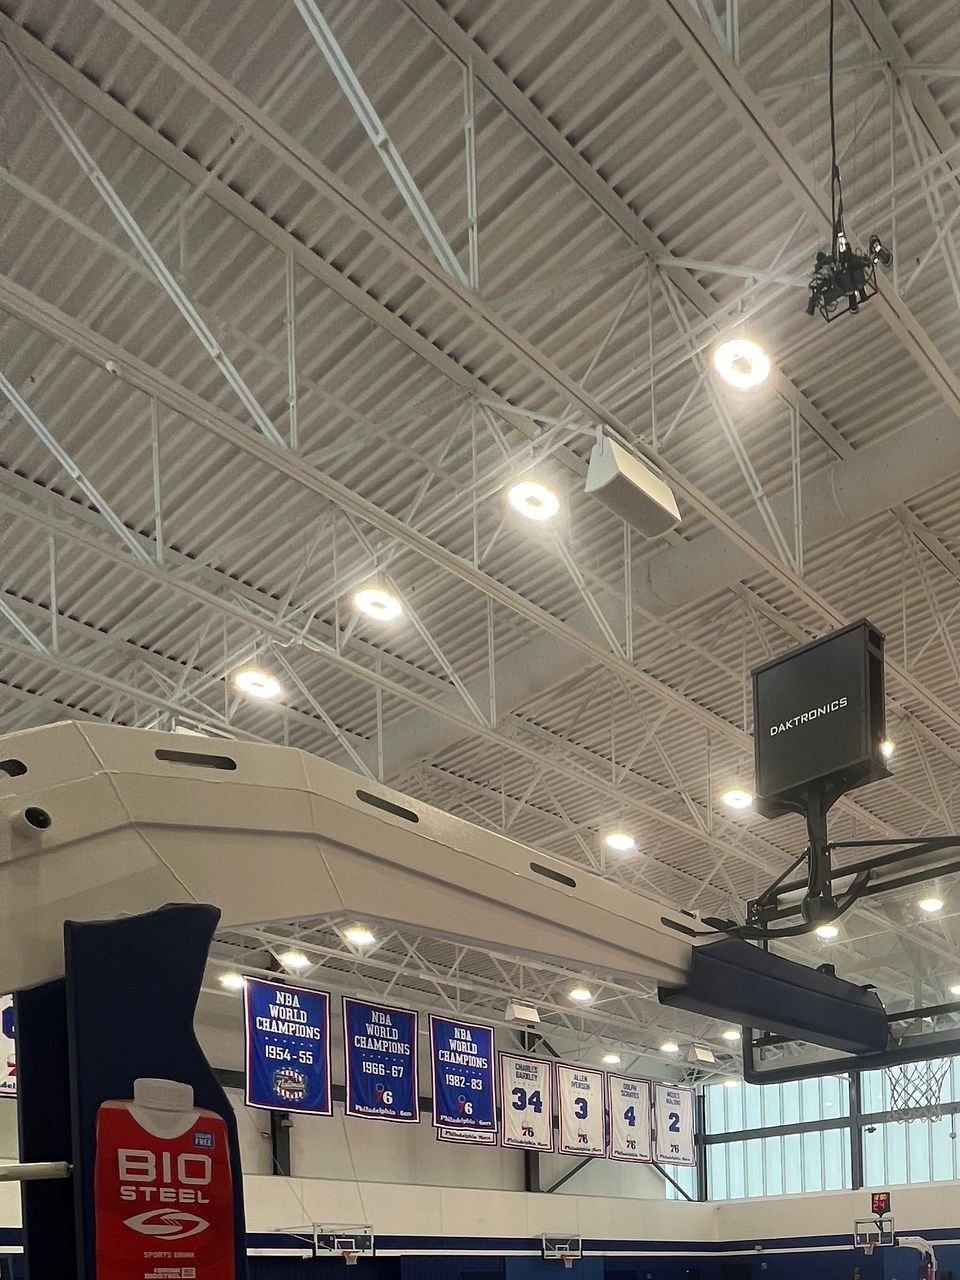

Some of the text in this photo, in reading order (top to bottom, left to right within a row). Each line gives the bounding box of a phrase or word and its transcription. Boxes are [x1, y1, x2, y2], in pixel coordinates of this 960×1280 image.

[769, 696, 848, 736] DAKTRONICS
[276, 991, 300, 1008] NBA
[269, 1004, 308, 1023] WORLD
[371, 1011, 392, 1026] NBA
[256, 1017, 320, 1040] CHAMPIONS
[366, 1024, 398, 1040] WORLD
[454, 1028, 472, 1042] NBA
[354, 1036, 410, 1055] CHAMPIONS
[448, 1039, 478, 1054] WORLD
[265, 1045, 313, 1064] 1954-55
[438, 1050, 488, 1069] CHAMPIONS
[362, 1062, 404, 1078] 1966-67
[446, 1074, 482, 1090] 1982-83
[355, 1104, 396, 1114] Philadelphia
[512, 1087, 542, 1114] 34
[575, 1098, 588, 1120] 3
[624, 1106, 635, 1126] 4
[669, 1112, 680, 1132] 2
[522, 1126, 534, 1138] 76
[578, 1134, 588, 1144] 76
[195, 1138, 212, 1146] FREE
[626, 1139, 636, 1149] 76
[670, 1144, 679, 1153] 76
[118, 1148, 212, 1185] BIO
[120, 1186, 210, 1204] STEEL
